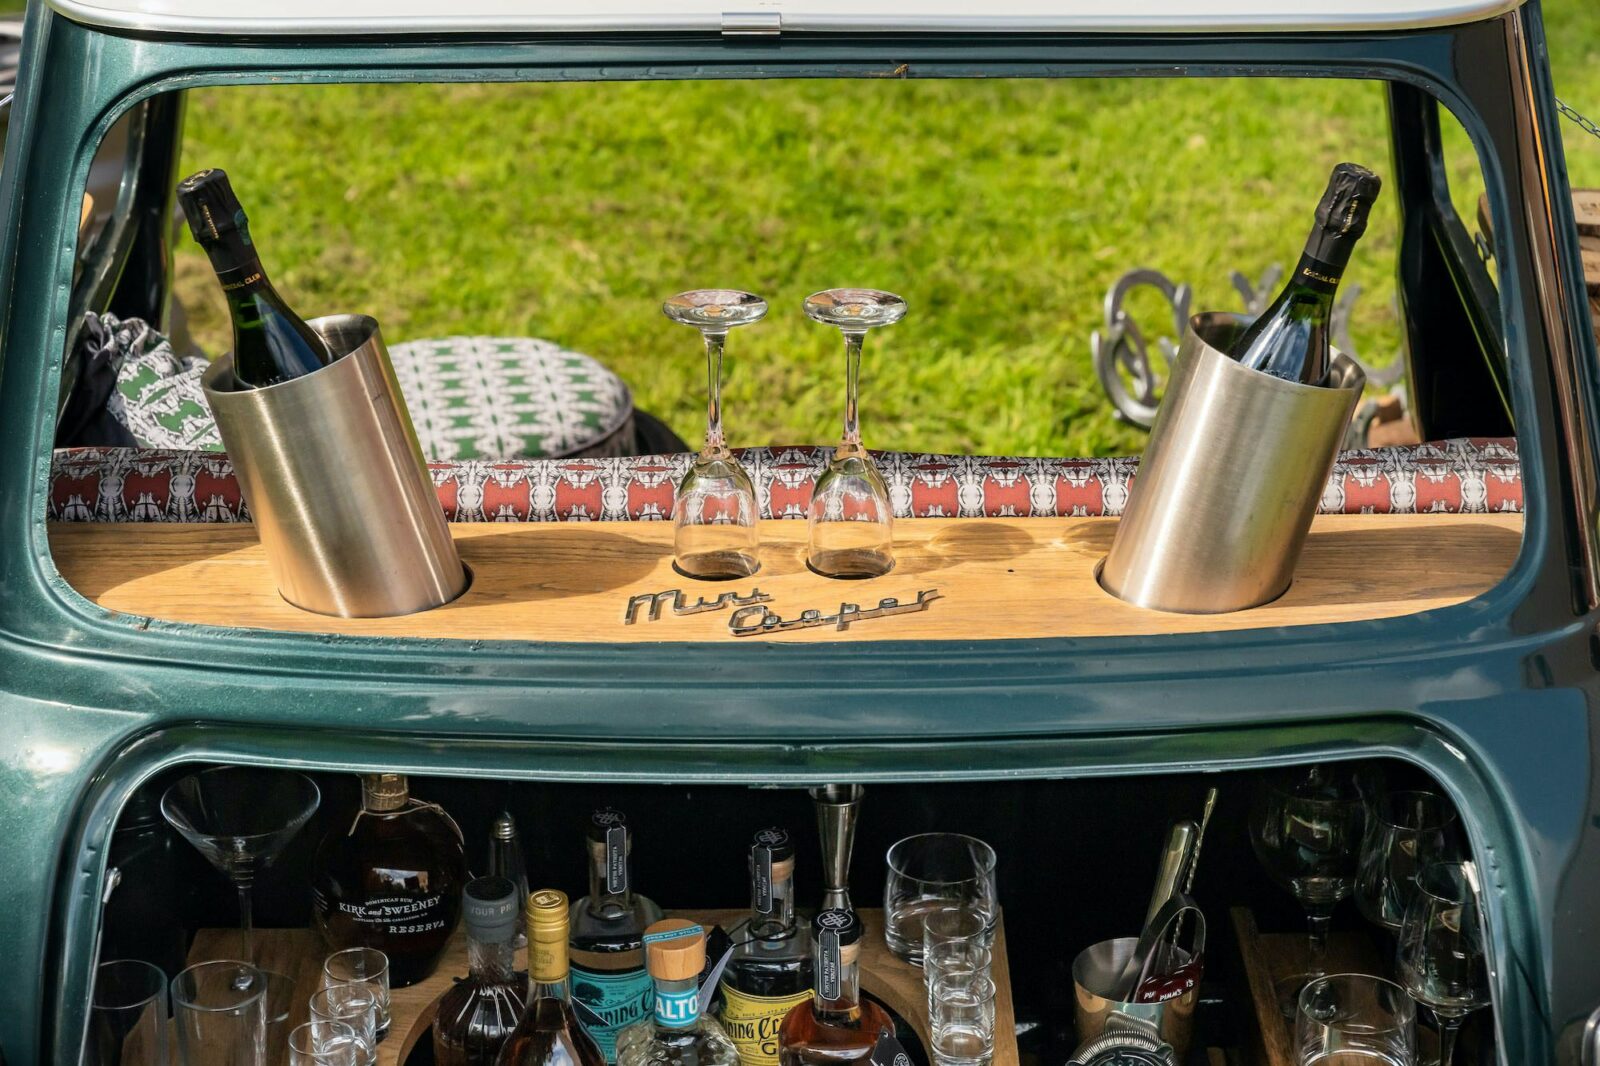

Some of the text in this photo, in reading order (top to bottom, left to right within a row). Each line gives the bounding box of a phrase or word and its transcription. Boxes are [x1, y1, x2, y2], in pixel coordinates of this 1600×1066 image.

[624, 587, 771, 625] Mini
[727, 588, 944, 637] Cooper
[338, 902, 368, 918] KIRK
[381, 895, 441, 916] SWEENEY
[388, 919, 445, 934] RESERVA
